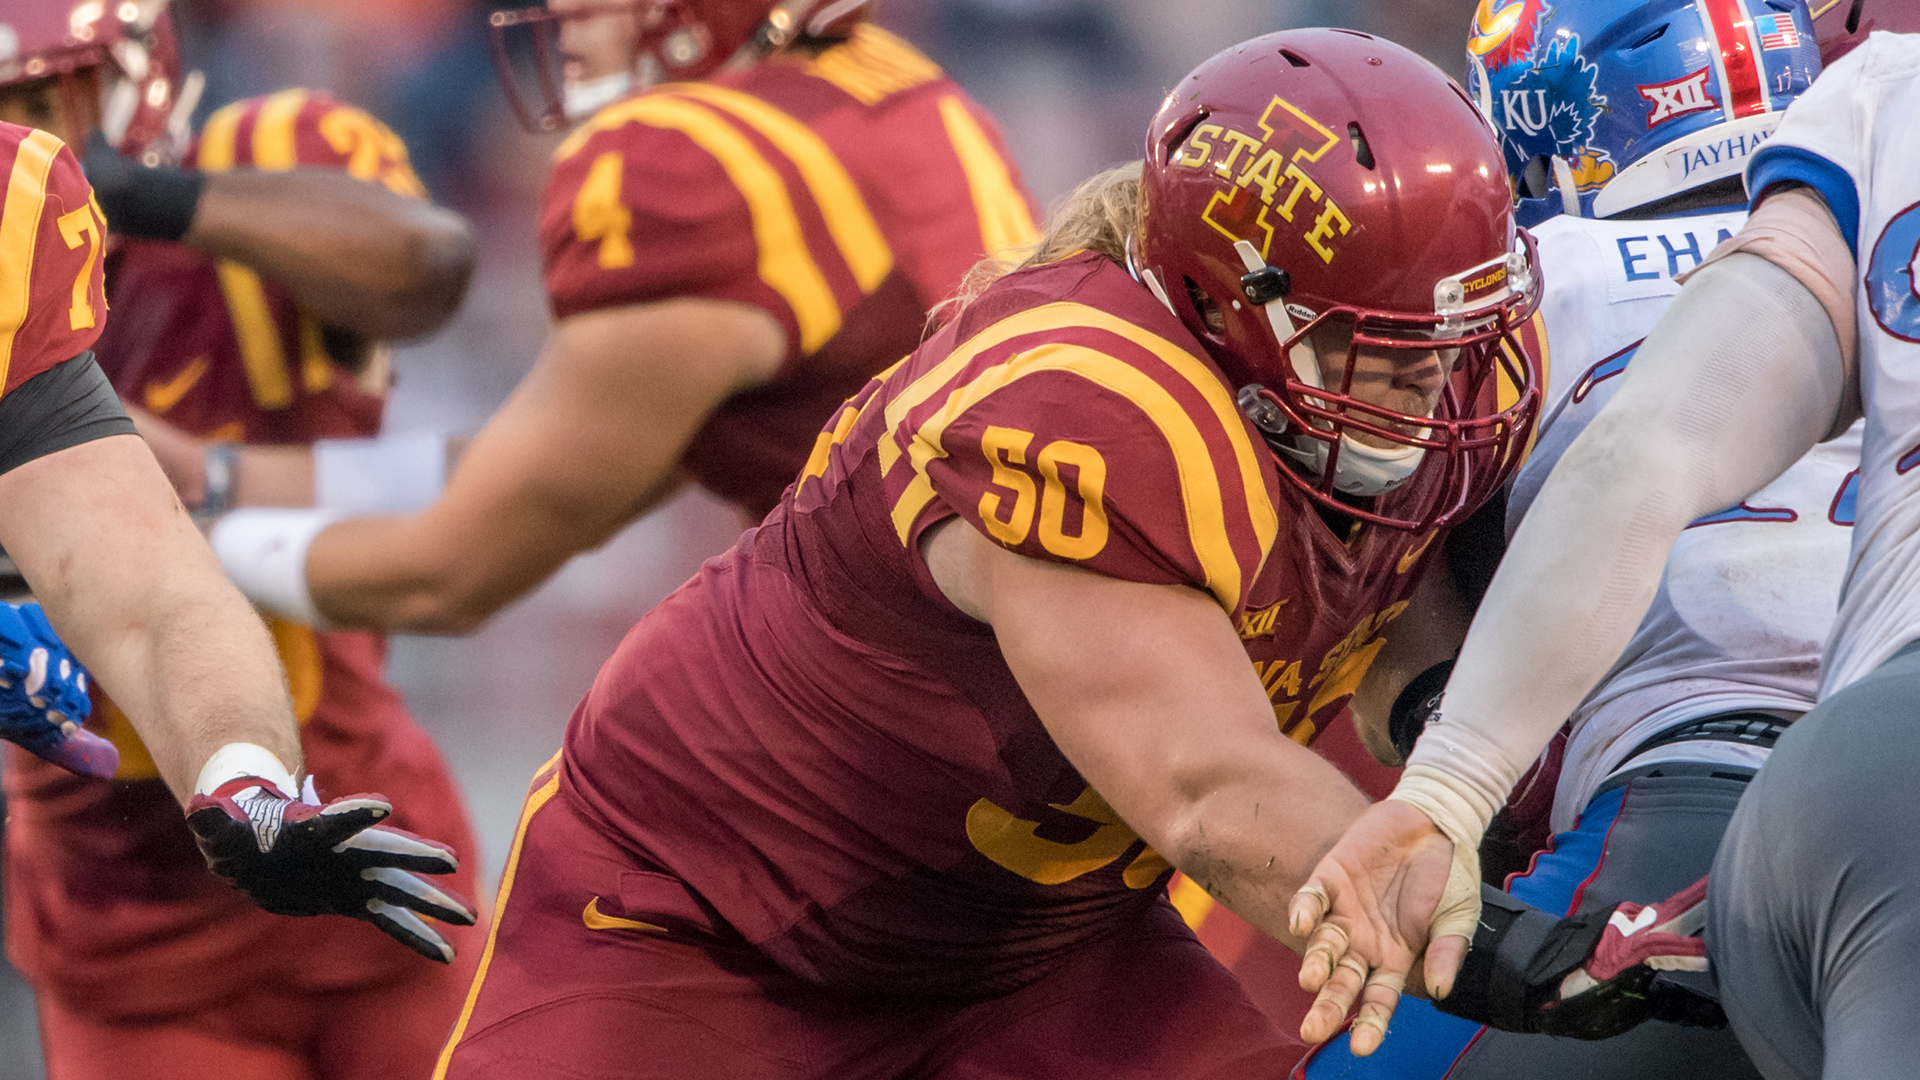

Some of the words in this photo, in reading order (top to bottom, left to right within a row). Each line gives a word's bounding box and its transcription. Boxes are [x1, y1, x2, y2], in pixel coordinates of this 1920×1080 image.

[1500, 89, 1547, 136] KU
[1638, 68, 1717, 127] XII
[1180, 124, 1351, 264] STATE
[1682, 130, 1768, 180] JAYHA
[572, 151, 636, 269] 4
[57, 186, 109, 331] 7
[1463, 267, 1506, 293] CYCLONES
[978, 426, 1110, 560] 50
